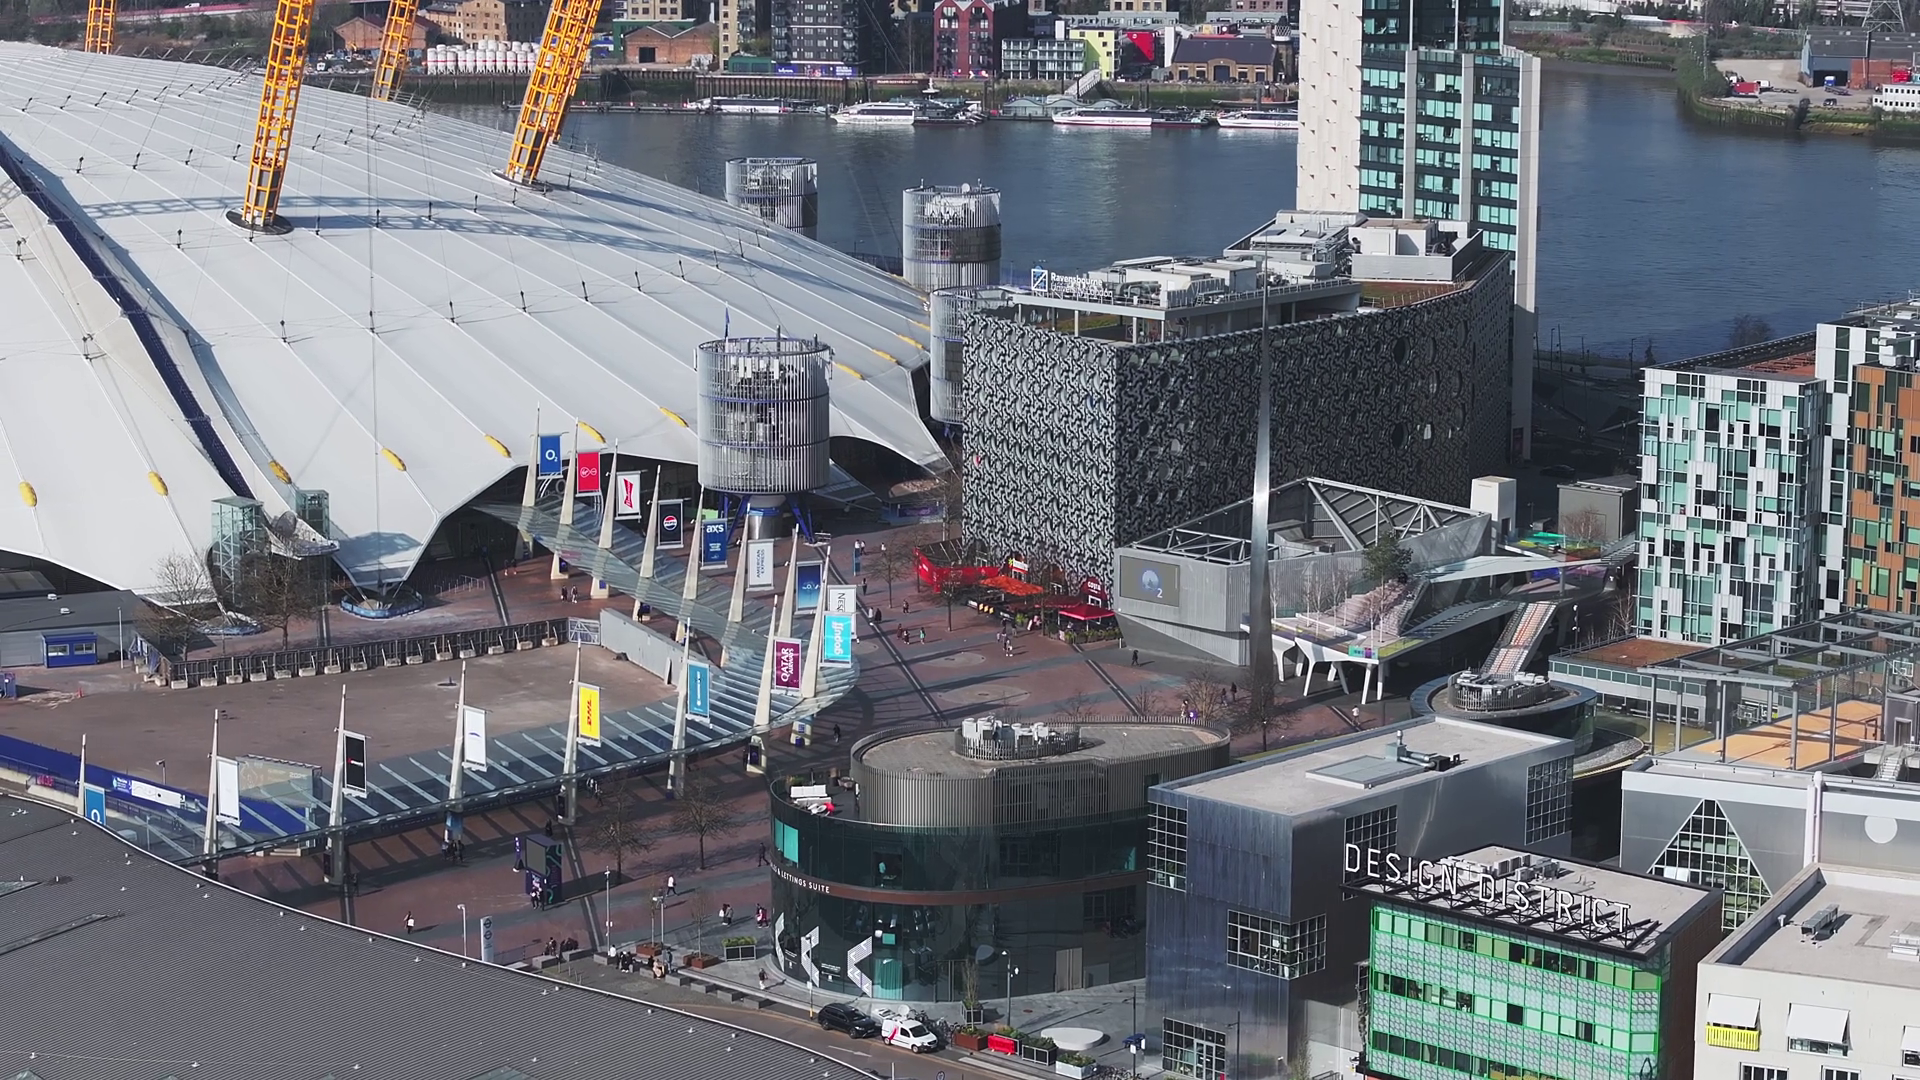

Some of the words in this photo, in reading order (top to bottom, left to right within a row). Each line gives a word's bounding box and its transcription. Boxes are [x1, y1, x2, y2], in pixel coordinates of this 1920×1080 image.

[1050, 272, 1103, 285] Ravensbourne
[545, 449, 558, 462] O2
[706, 525, 724, 534] axs
[831, 621, 844, 655] gopuff
[780, 648, 789, 682] QATAR
[781, 870, 807, 887] LETTINGS
[808, 882, 830, 893] SUITE
[1345, 843, 1457, 895] DESIGN
[1478, 874, 1631, 933] DISTRICT
